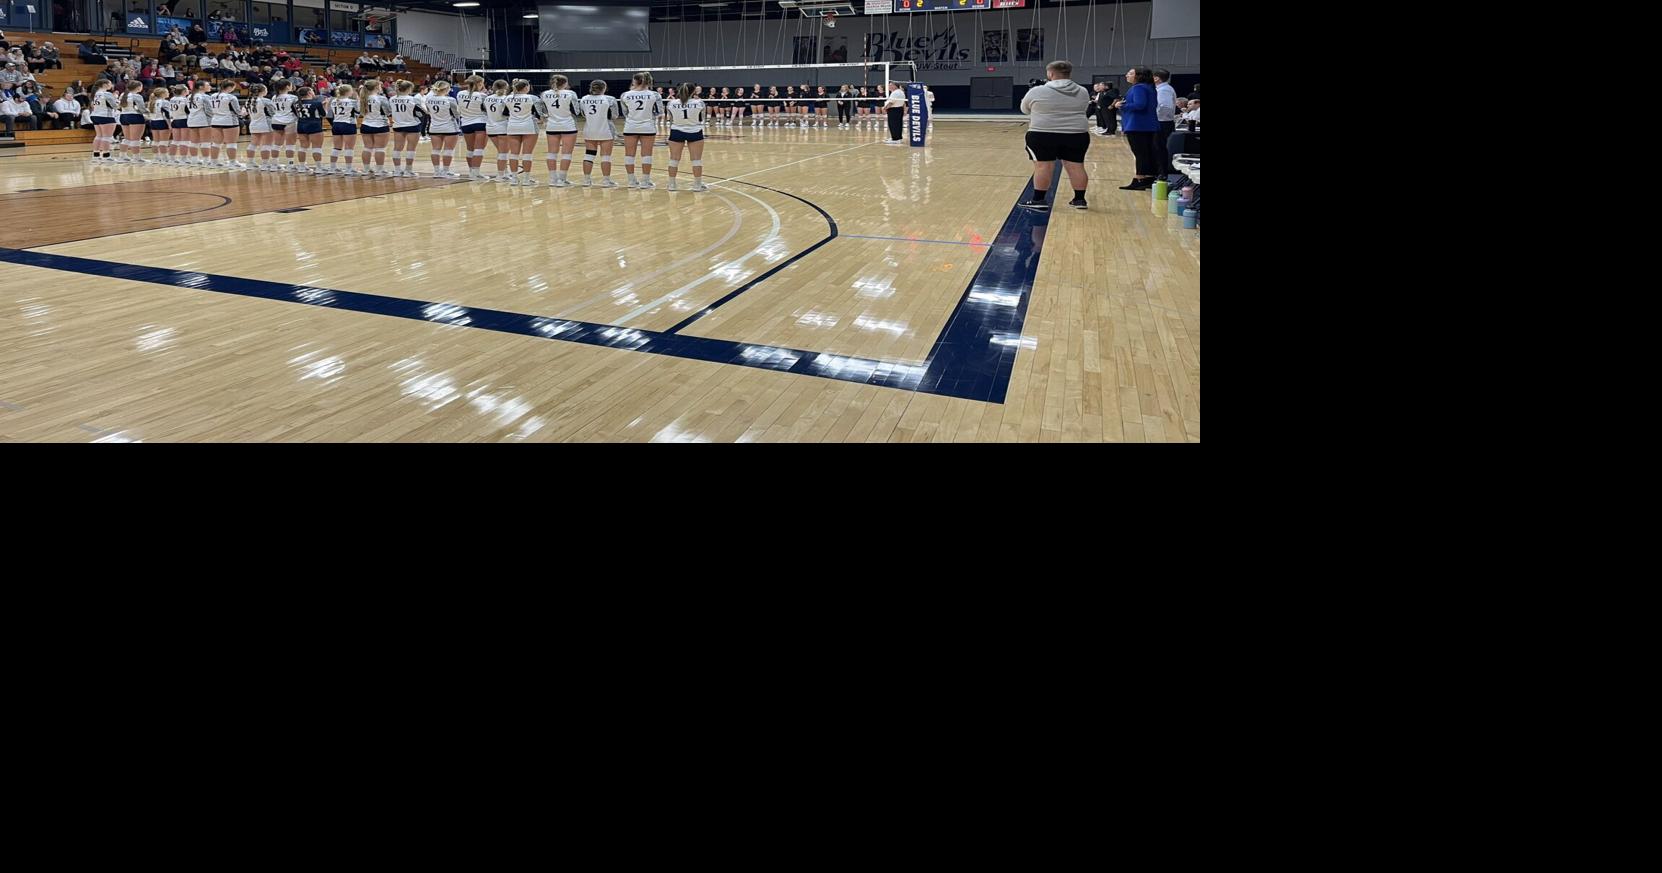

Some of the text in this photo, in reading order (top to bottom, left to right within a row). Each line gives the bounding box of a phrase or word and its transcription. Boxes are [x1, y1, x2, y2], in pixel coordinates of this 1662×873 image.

[860, 31, 932, 58] Blue
[868, 41, 970, 72] Devils
[211, 100, 221, 109] 17
[395, 103, 407, 113] 10
[432, 104, 440, 114] 9
[463, 99, 471, 109] 7
[489, 103, 497, 113] 6
[513, 102, 522, 113] 5
[551, 99, 561, 109] 4
[635, 100, 644, 111] 2
[911, 94, 921, 114] BLUE
[333, 106, 346, 115] 12
[588, 104, 597, 115] 3
[681, 109, 688, 119] 1
[912, 115, 921, 142] DEVILS
